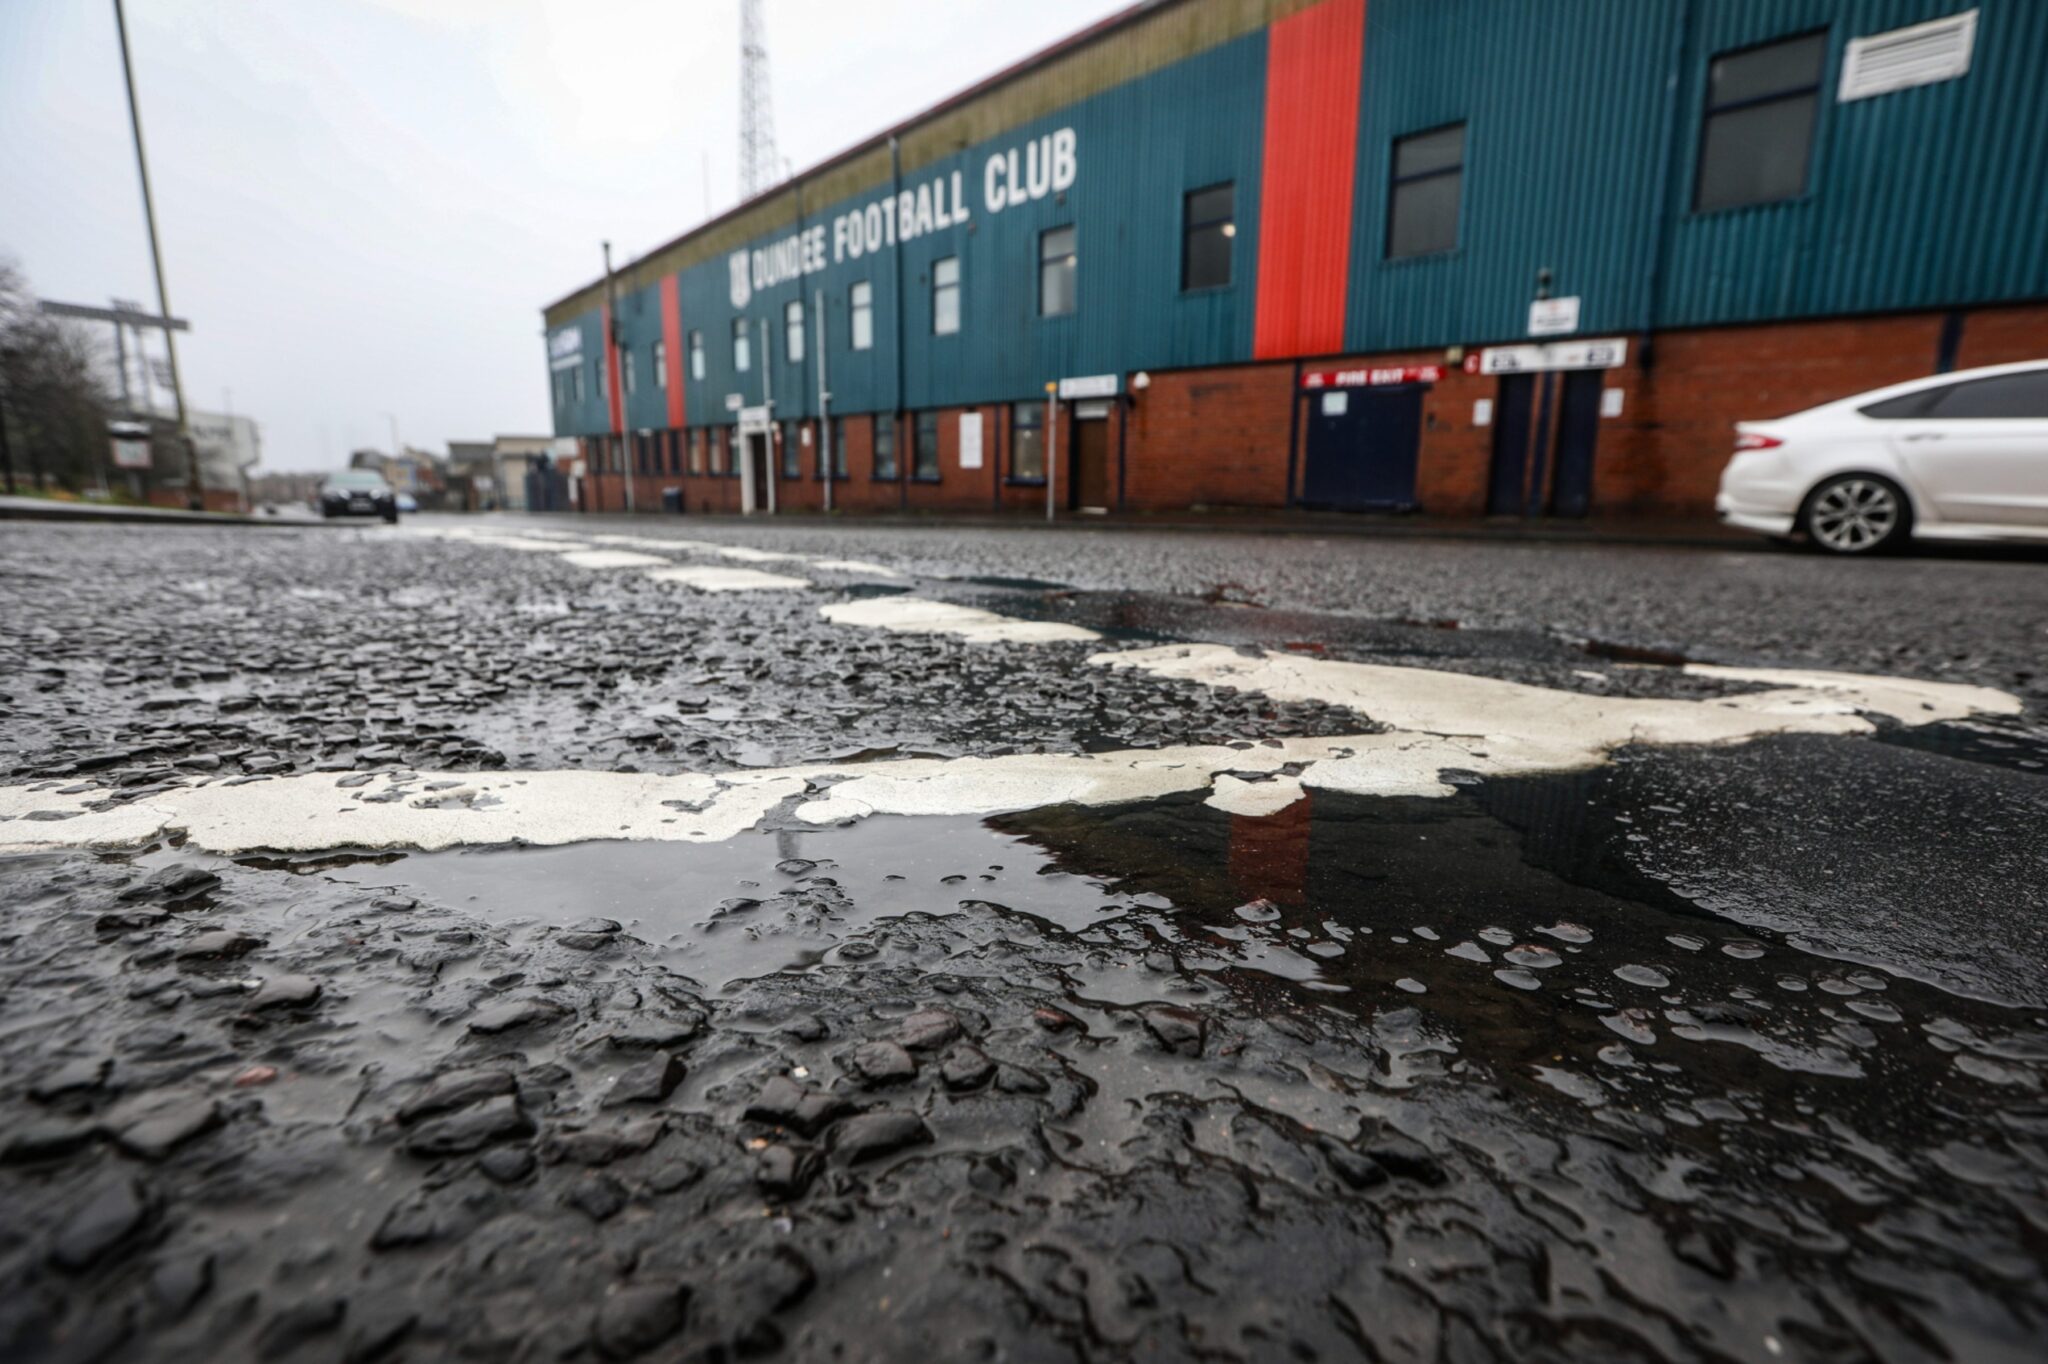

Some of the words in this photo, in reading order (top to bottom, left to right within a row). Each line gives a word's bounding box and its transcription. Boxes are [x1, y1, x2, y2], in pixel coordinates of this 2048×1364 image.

[752, 225, 827, 290] DUNDEE
[834, 170, 970, 263] FOOTBALL
[984, 127, 1077, 213] CLUB
[1335, 369, 1367, 387] FIRE
[1369, 367, 1404, 385] EXIT
